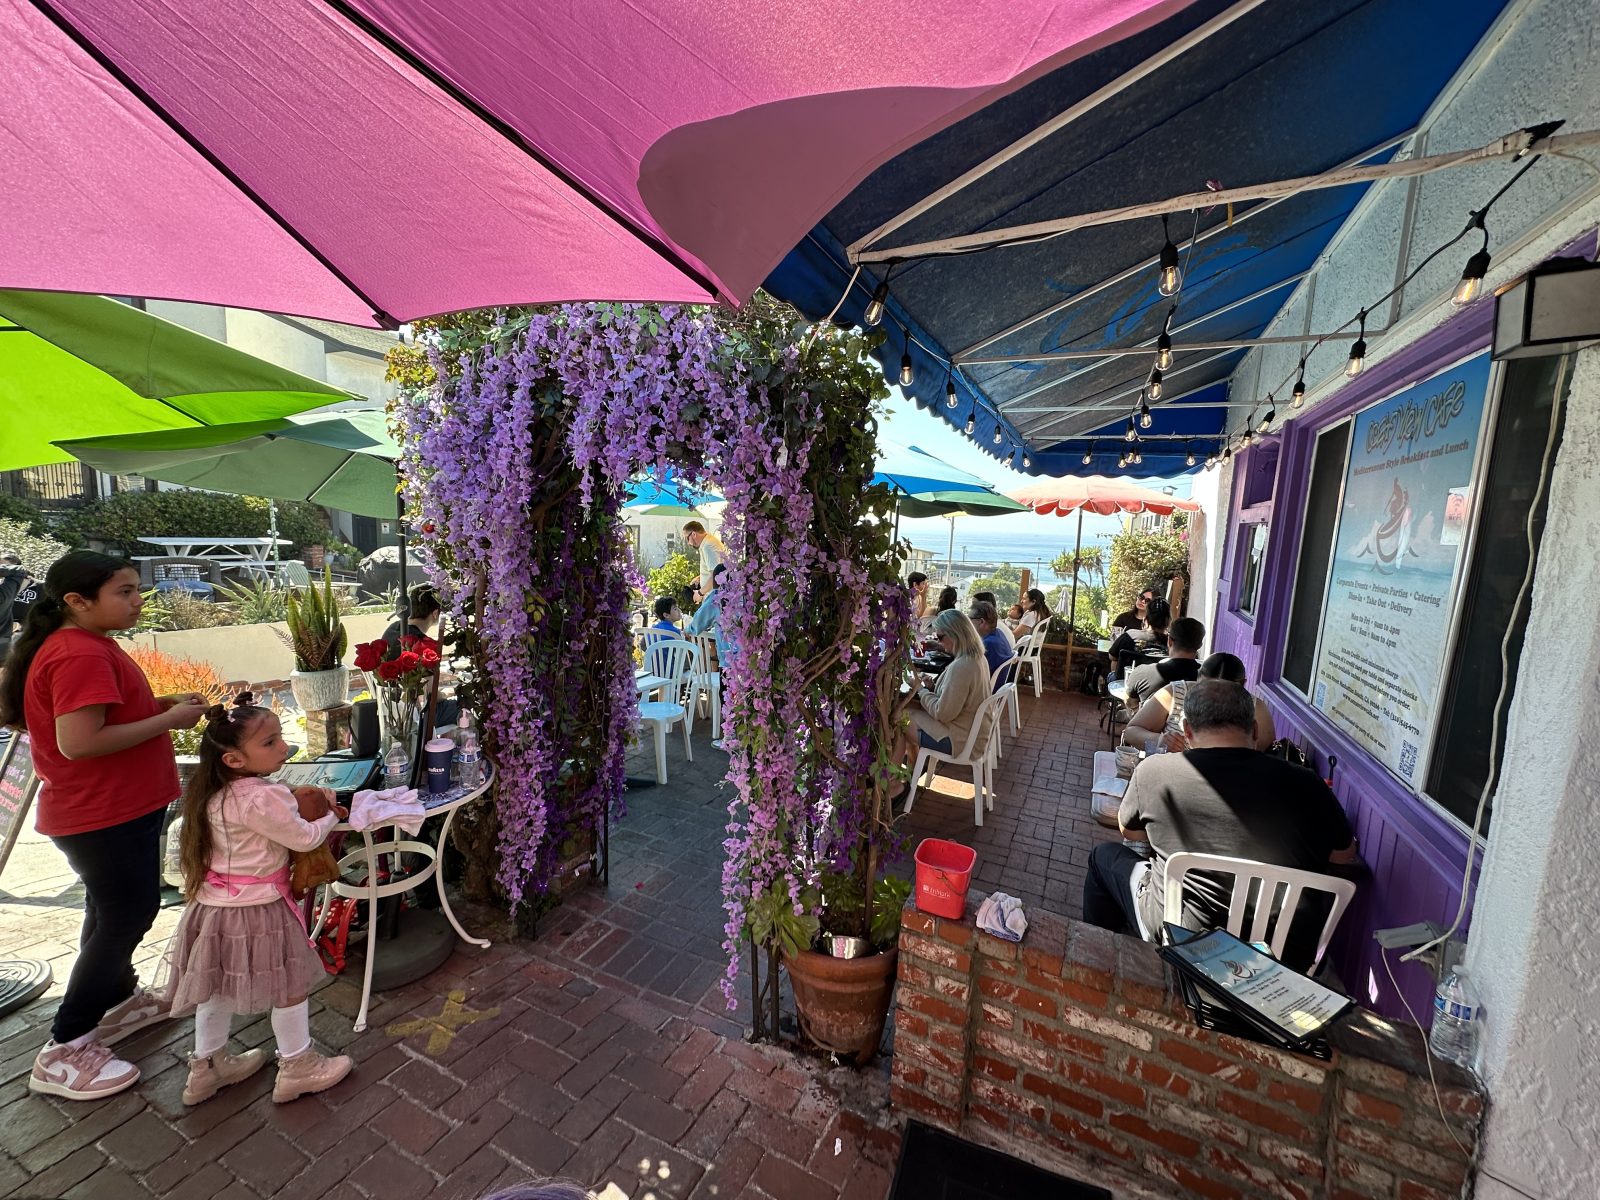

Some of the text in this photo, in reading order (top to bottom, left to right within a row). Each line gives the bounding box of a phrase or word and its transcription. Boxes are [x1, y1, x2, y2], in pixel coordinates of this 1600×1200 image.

[1353, 438, 1470, 475] Mediterranean Style Breakfast and Lunch
[1336, 577, 1442, 608] Corporate Events Private Parties Catering
[1366, 596, 1377, 605] Take
[1378, 599, 1387, 608] Out
[1390, 602, 1414, 616] Delivery
[1380, 636, 1386, 644] to
[1351, 651, 1360, 660] Credit
[1385, 668, 1399, 681] charge
[1385, 679, 1402, 695] separate
[1402, 688, 1418, 702] checks
